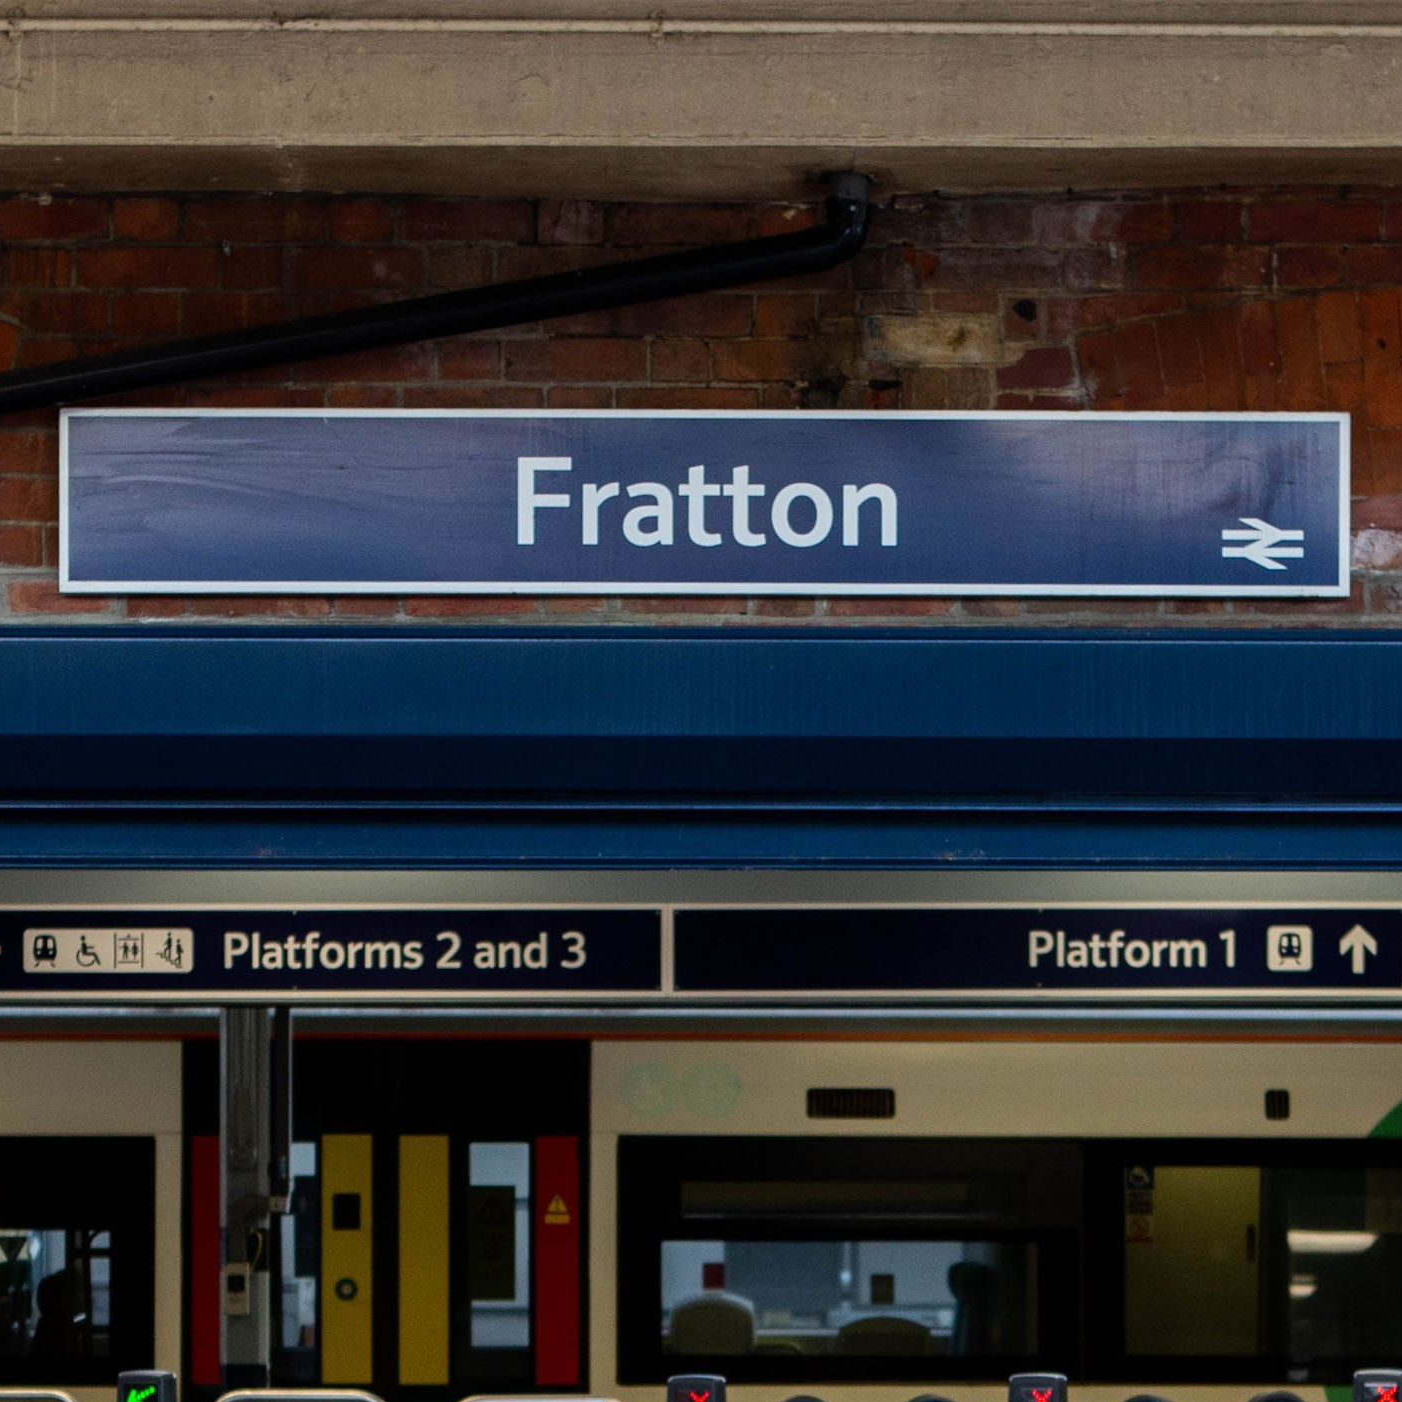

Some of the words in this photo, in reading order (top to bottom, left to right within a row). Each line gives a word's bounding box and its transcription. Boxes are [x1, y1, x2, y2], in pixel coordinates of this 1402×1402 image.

[516, 456, 899, 548] Fratton
[224, 931, 423, 970] Platforms
[435, 931, 463, 970] 2
[474, 930, 549, 970] and
[560, 931, 588, 970] 3
[1027, 929, 1207, 969] Platform
[1219, 930, 1237, 967] 1
